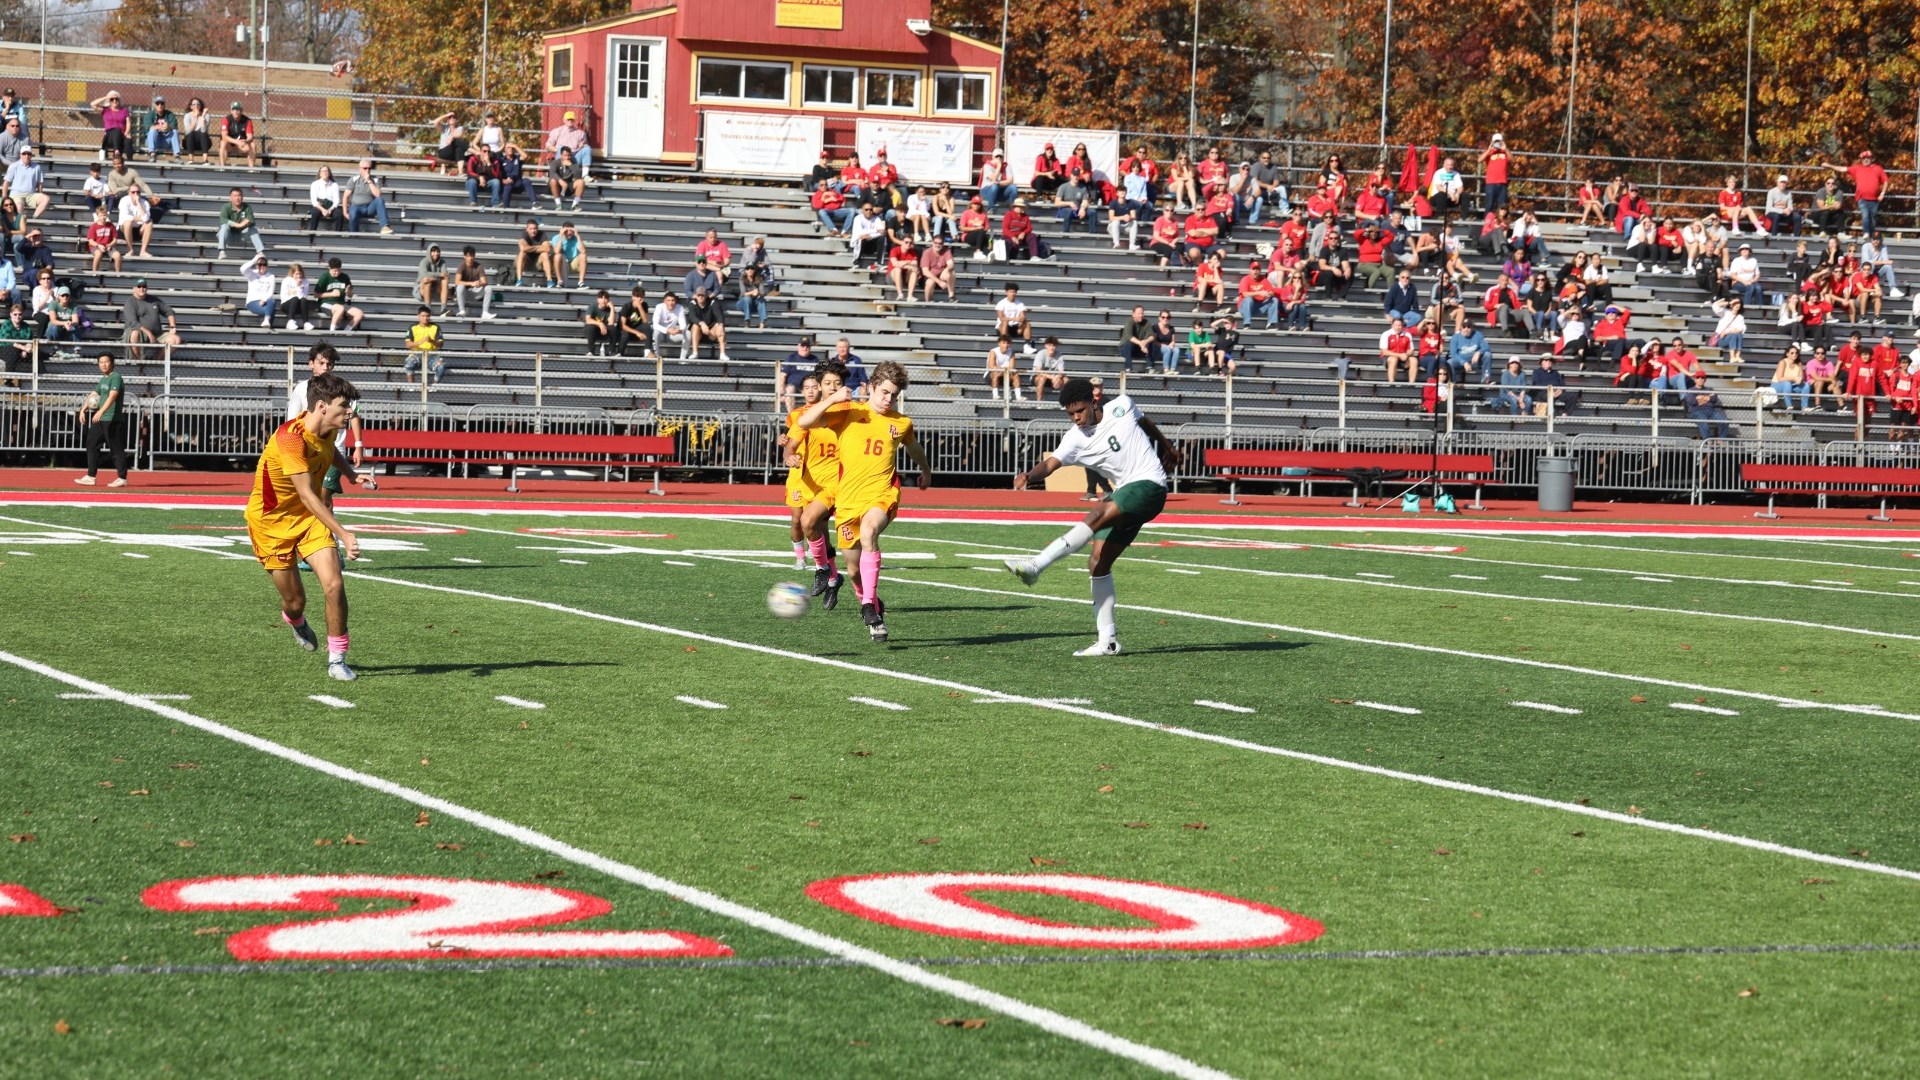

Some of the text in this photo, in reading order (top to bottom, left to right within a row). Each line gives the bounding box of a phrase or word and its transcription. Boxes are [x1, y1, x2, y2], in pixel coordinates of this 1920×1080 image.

[819, 442, 837, 457] 12
[864, 438, 884, 457] 16
[1108, 435, 1121, 452] 8
